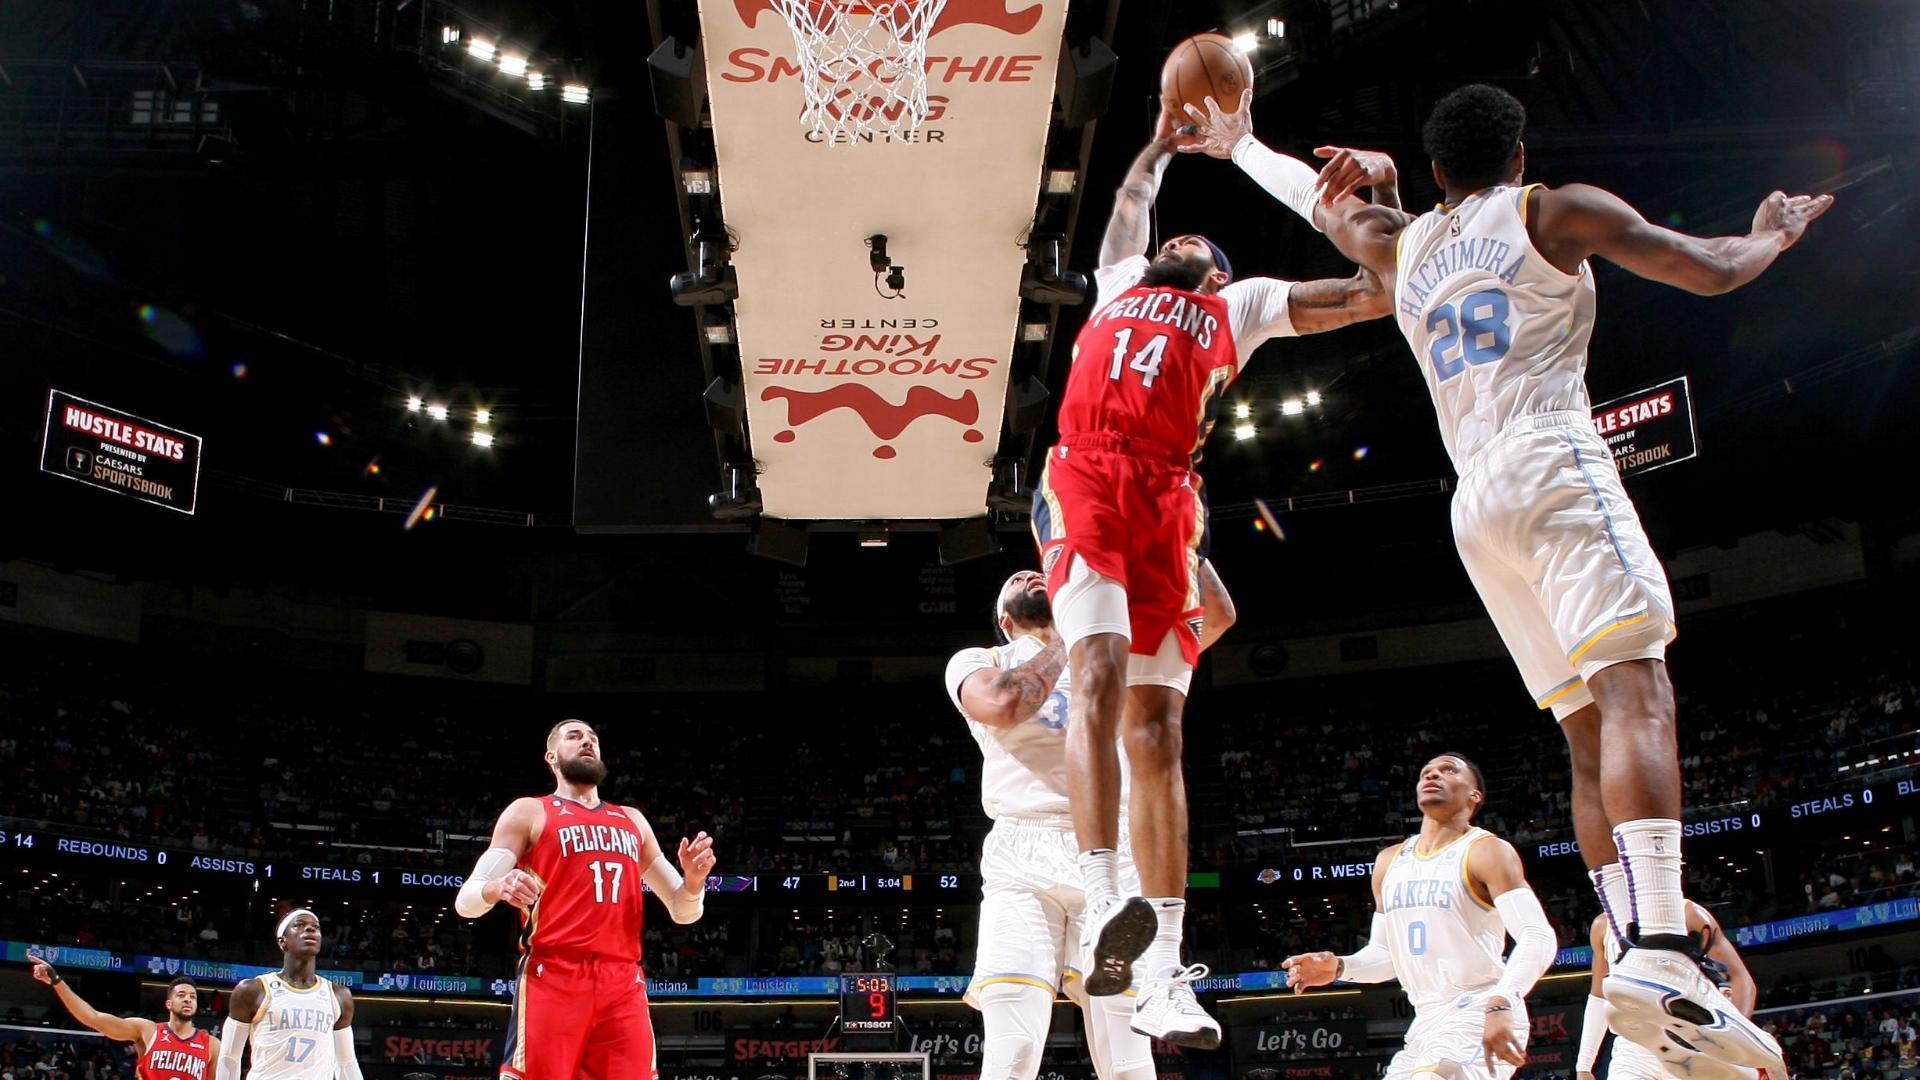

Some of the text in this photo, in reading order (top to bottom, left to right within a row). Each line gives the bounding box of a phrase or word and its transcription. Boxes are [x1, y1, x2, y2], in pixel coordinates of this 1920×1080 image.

[721, 48, 1042, 83] SMOOTHIE
[804, 129, 945, 143] CENTER
[1400, 237, 1526, 321] HACHIMURA
[820, 318, 939, 329] CENTER
[1092, 292, 1217, 350] PELICANS
[1426, 287, 1510, 383] 28
[753, 358, 998, 379] SMOOTHIE
[1109, 327, 1169, 389] 14
[1619, 394, 1672, 428] STATS
[65, 407, 184, 460] HUSTLE STATS
[1626, 430, 1636, 439] BY
[100, 442, 147, 463] PRESENTED BY
[95, 455, 143, 476] CAESARS
[94, 465, 173, 501] SPORTSBOOK
[1040, 691, 1068, 730] 3
[1791, 793, 1854, 818] STEALS
[1863, 789, 1873, 804] 0
[1681, 817, 1743, 838] SSISTS
[1751, 813, 1761, 828] 0
[558, 824, 640, 864] PELICANS
[15, 833, 34, 848] 14
[58, 838, 148, 862] REBOUNDS
[157, 852, 167, 865] 0
[191, 855, 255, 876] ASSISTS
[264, 864, 273, 878] 1
[302, 867, 361, 882] STEALS
[372, 871, 380, 884] 1
[401, 872, 463, 888] BLOCKS
[589, 860, 624, 904] 17
[782, 876, 957, 889] 47 2nd 5:04 52
[1293, 868, 1303, 881] 0
[1312, 866, 1327, 879] R.
[1385, 880, 1453, 913] LAKERS
[1408, 920, 1427, 956] 0
[1770, 915, 1831, 939] Louisiana
[63, 949, 122, 969] Louisiana
[183, 960, 238, 980] Louisiana
[413, 976, 467, 992] Louisiana
[745, 979, 799, 993] Louisiana
[857, 978, 888, 992] 5:03
[869, 993, 886, 1018] 9
[267, 1008, 334, 1035] LAKERS
[857, 1021, 892, 1029] TISSOT
[284, 1036, 317, 1063] 17
[384, 1035, 494, 1059] SEATGEEK
[733, 1037, 840, 1061] SEATGEEK
[910, 1034, 959, 1055] Let's
[1257, 1028, 1342, 1051] Let's Go
[150, 1050, 206, 1080] PELICANS
